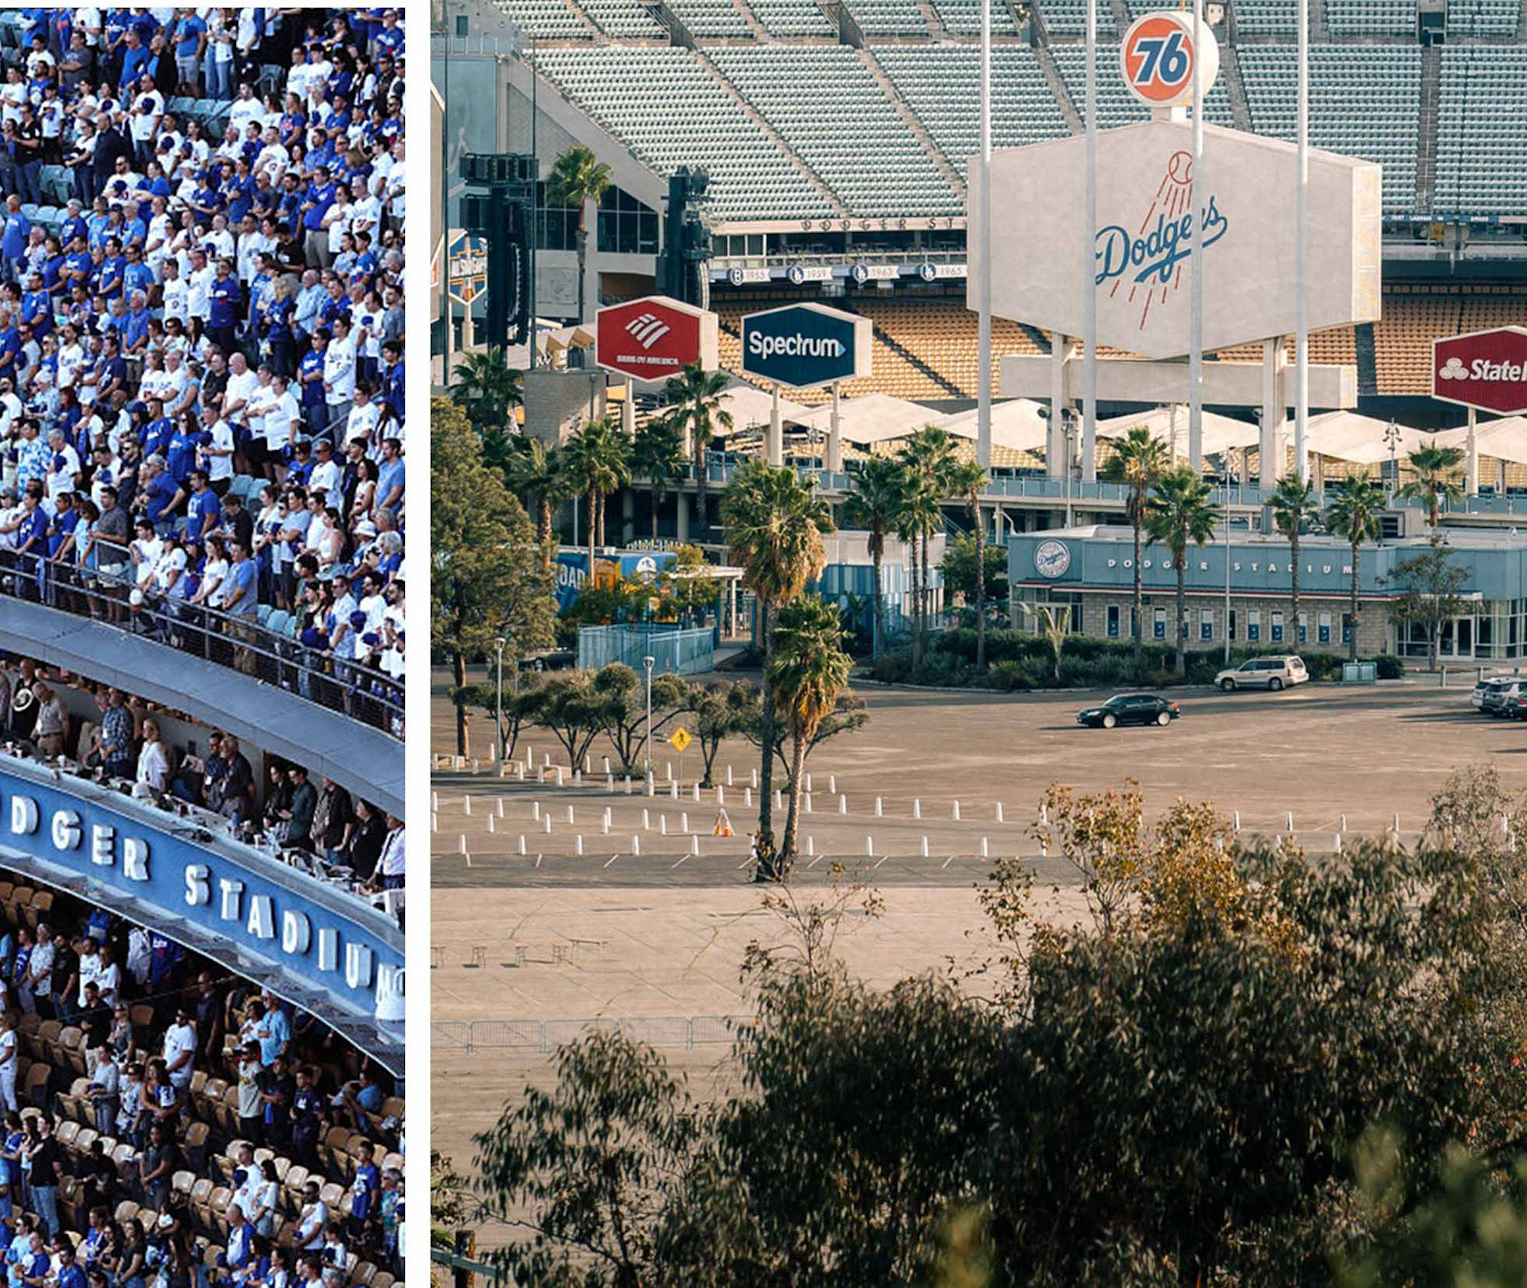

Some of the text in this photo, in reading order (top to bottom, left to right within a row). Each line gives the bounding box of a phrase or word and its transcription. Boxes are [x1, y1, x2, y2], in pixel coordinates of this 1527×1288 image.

[1133, 31, 1191, 86] 76
[801, 218, 907, 231] DODGER
[749, 331, 840, 360] Spectrum
[554, 563, 586, 591] OAD
[1108, 559, 1208, 570] DODGR
